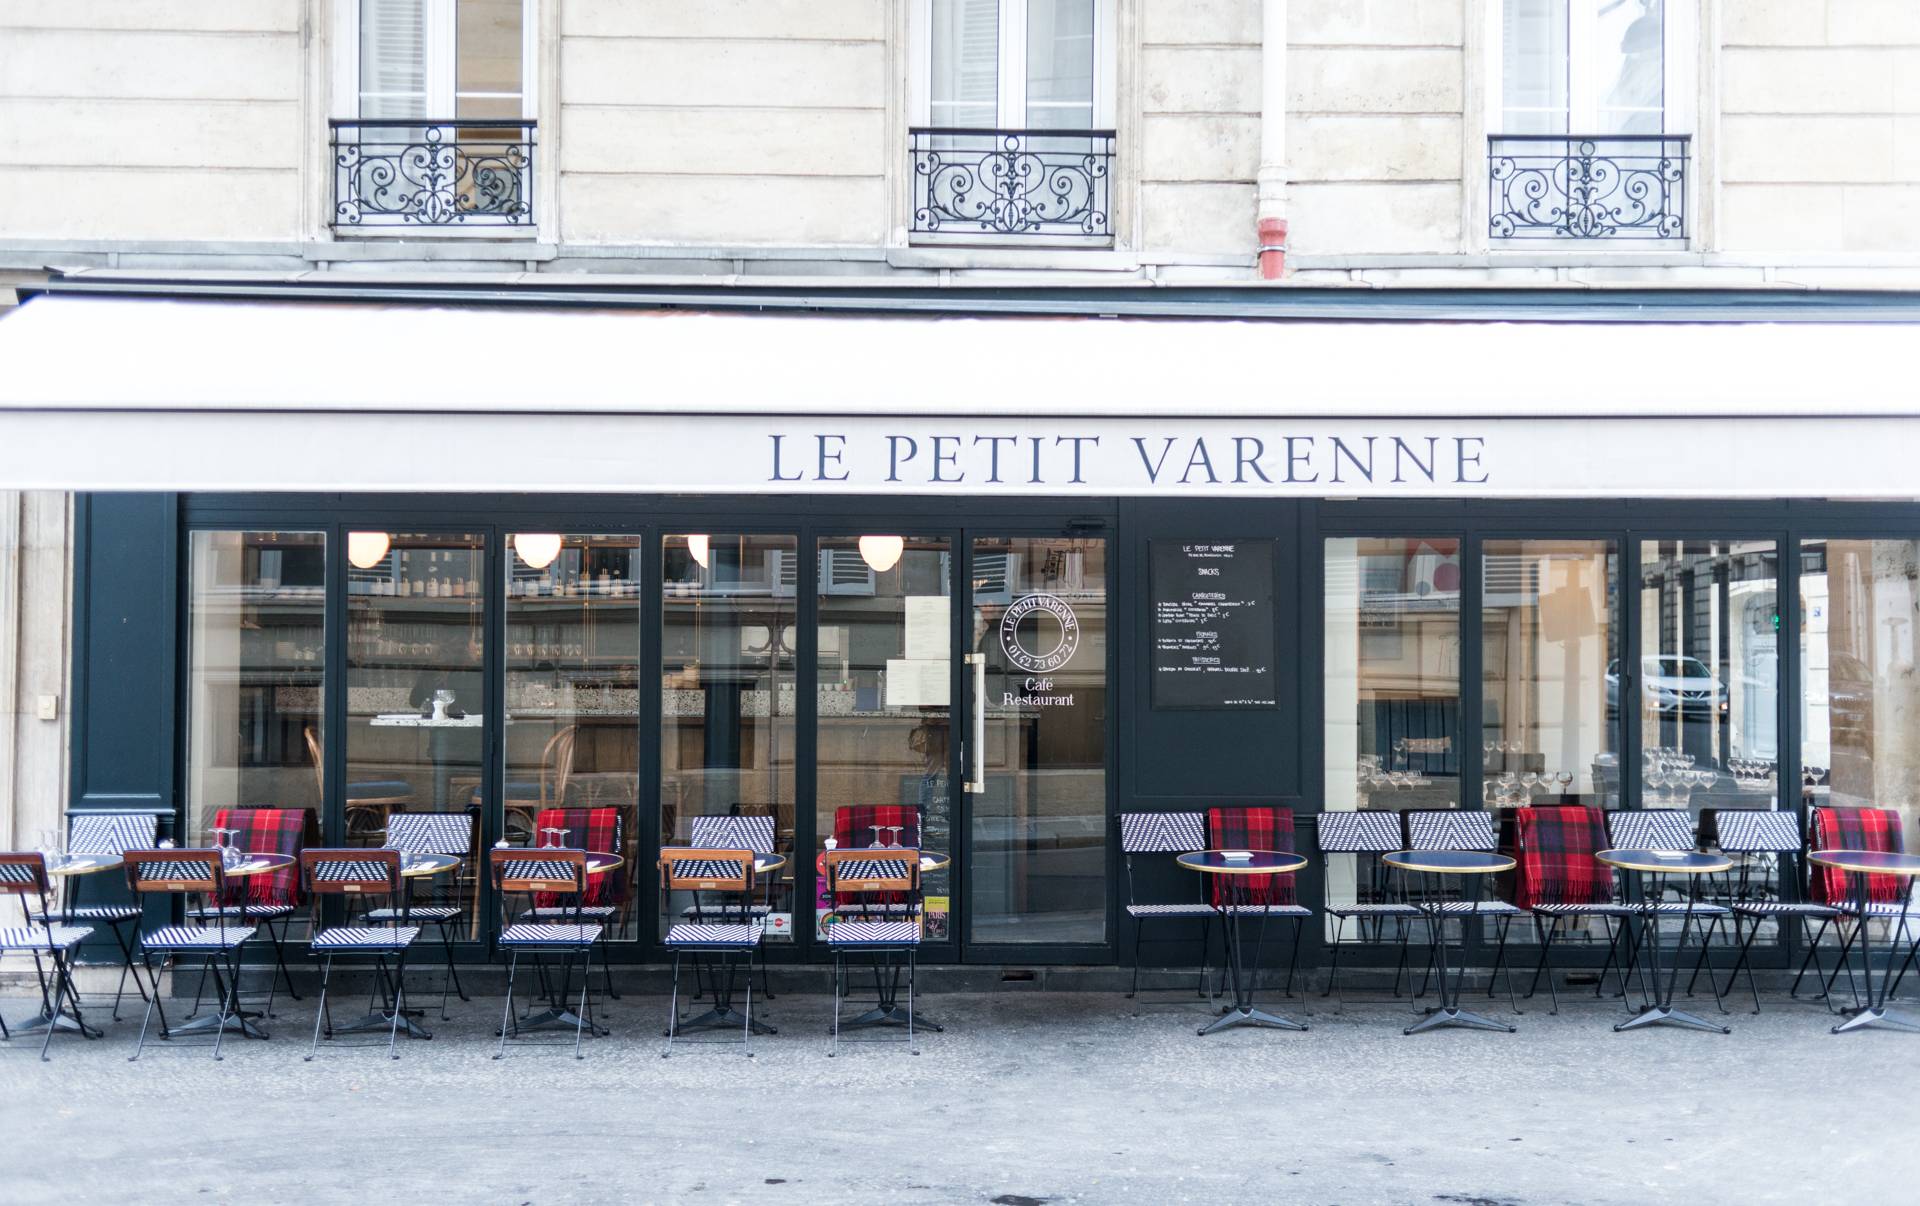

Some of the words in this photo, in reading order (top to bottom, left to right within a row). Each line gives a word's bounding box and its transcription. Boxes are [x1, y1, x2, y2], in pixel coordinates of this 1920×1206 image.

[768, 435, 849, 481] LE
[885, 435, 1099, 483] PETIT
[1130, 437, 1488, 484] VARENNE
[1198, 567, 1219, 576] SNACKS
[1004, 616, 1016, 632] LE
[1010, 598, 1037, 618] PETIT
[1038, 597, 1075, 632] VARENNE
[1008, 645, 1021, 658] 01
[1018, 655, 1032, 667] 42
[1034, 660, 1046, 669] 73
[1047, 654, 1060, 667] 60
[1059, 643, 1073, 657] 72
[1025, 677, 1053, 691] Café
[1003, 692, 1074, 706] Restaurant
